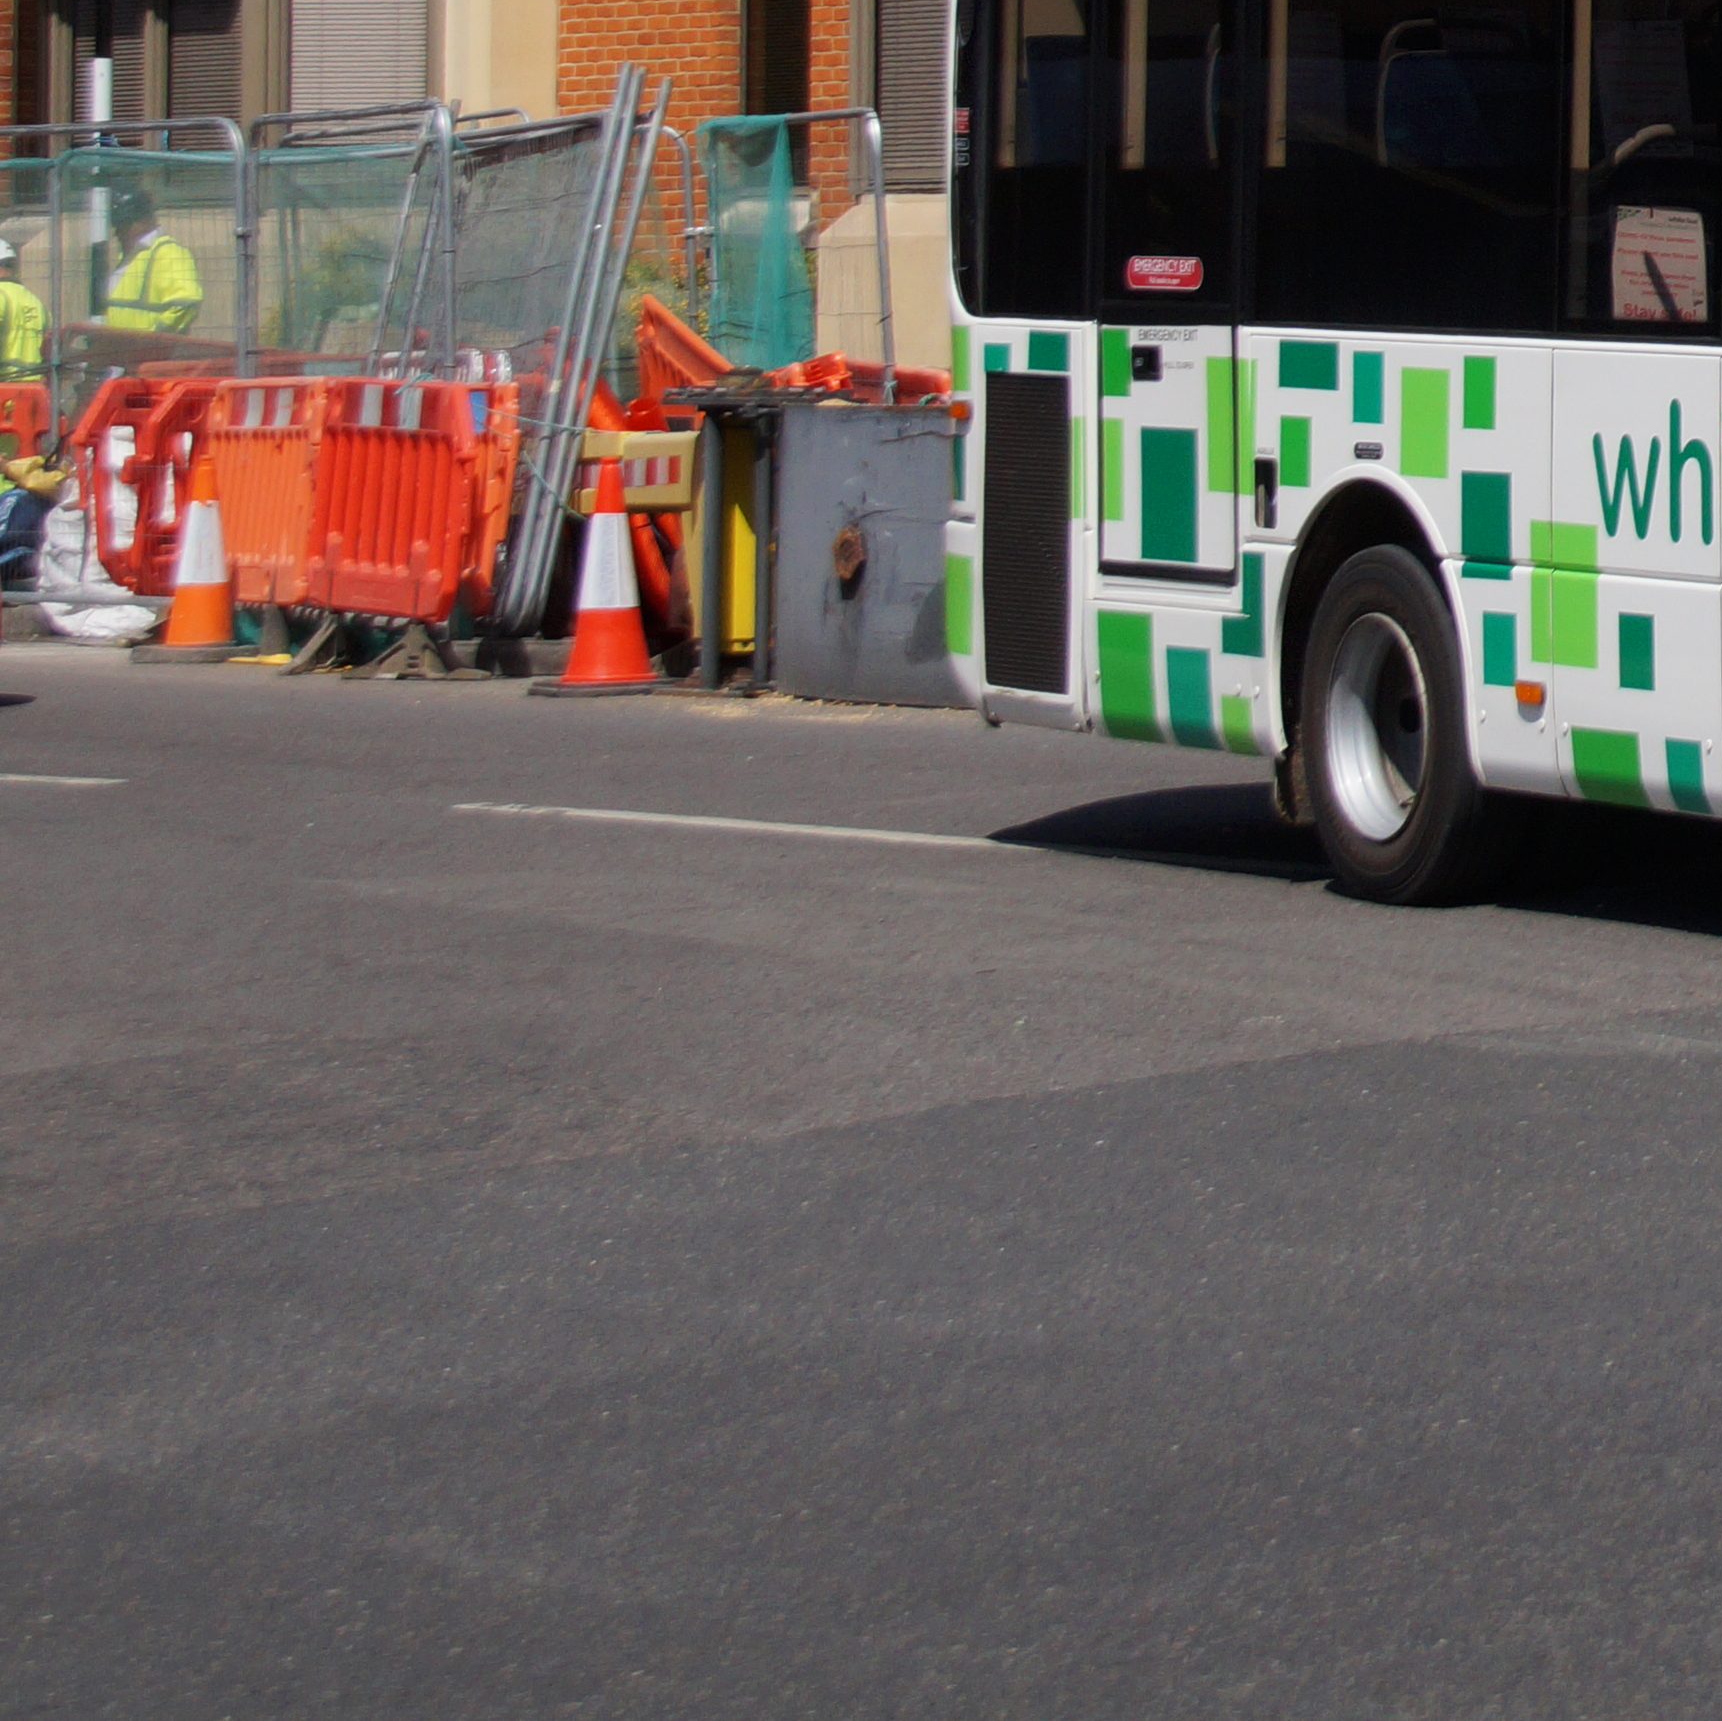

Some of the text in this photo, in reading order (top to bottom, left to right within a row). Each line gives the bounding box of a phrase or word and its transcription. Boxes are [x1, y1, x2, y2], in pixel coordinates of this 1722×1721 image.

[1133, 258, 1197, 273] EMERGENCY EXIT
[1623, 302, 1698, 319] Stay sfe!
[1138, 328, 1198, 342] EMERGENCY EXIT
